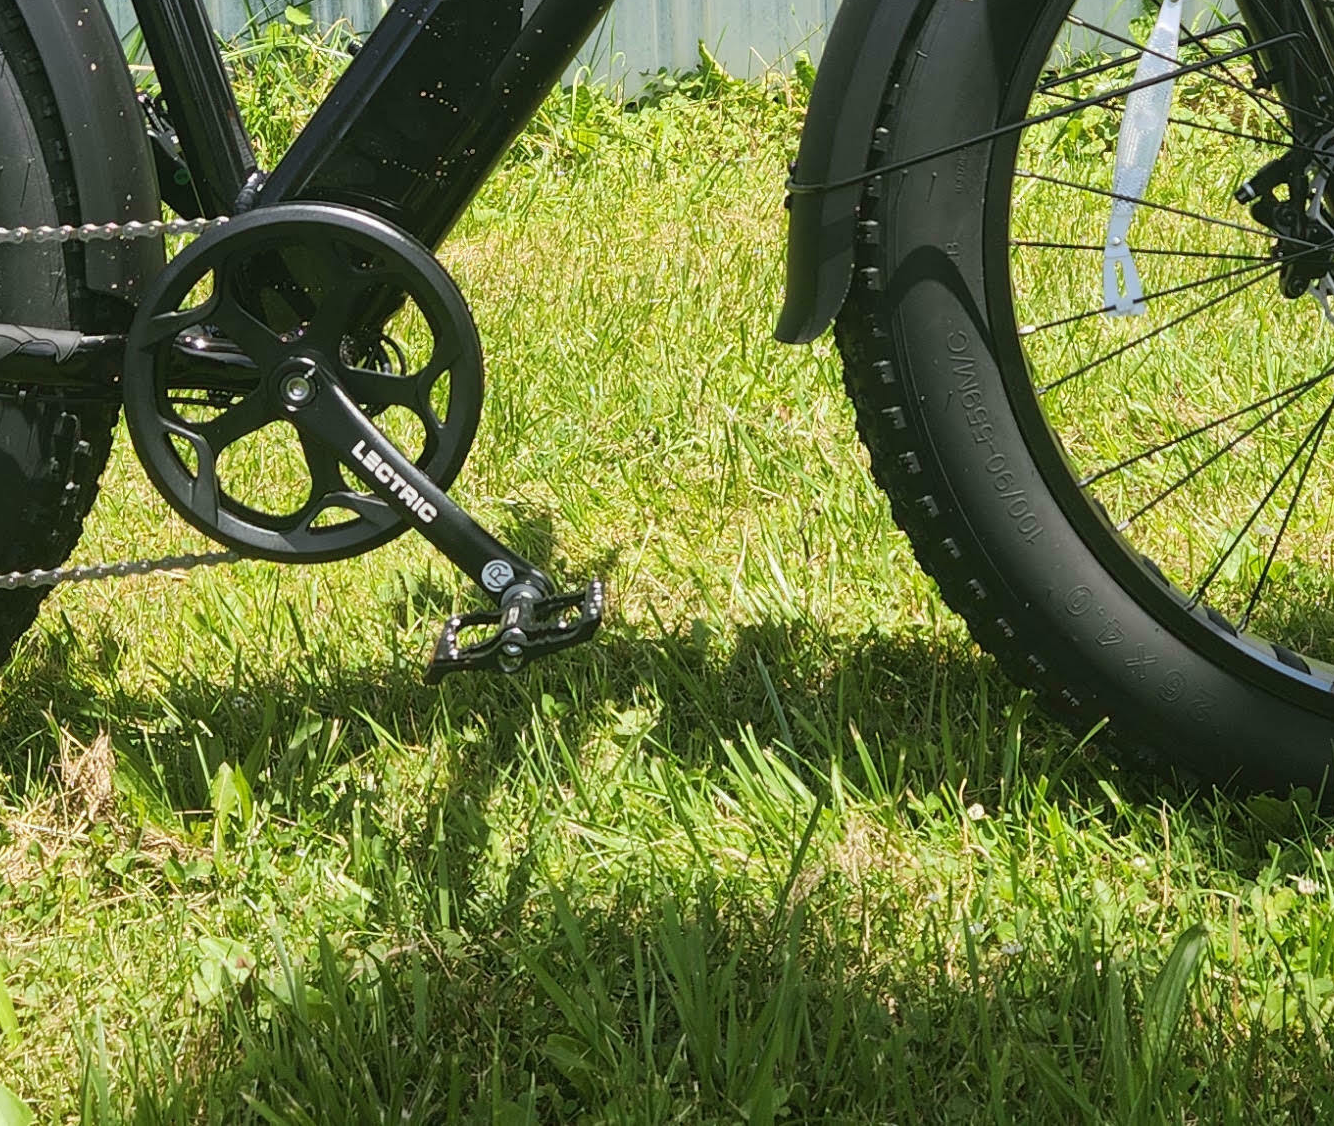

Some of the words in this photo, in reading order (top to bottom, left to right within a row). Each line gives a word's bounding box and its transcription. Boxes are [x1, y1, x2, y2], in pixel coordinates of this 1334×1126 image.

[947, 330, 1044, 545] 100/90-559M/C
[351, 439, 437, 524] LECTRIC
[489, 566, 508, 585] R
